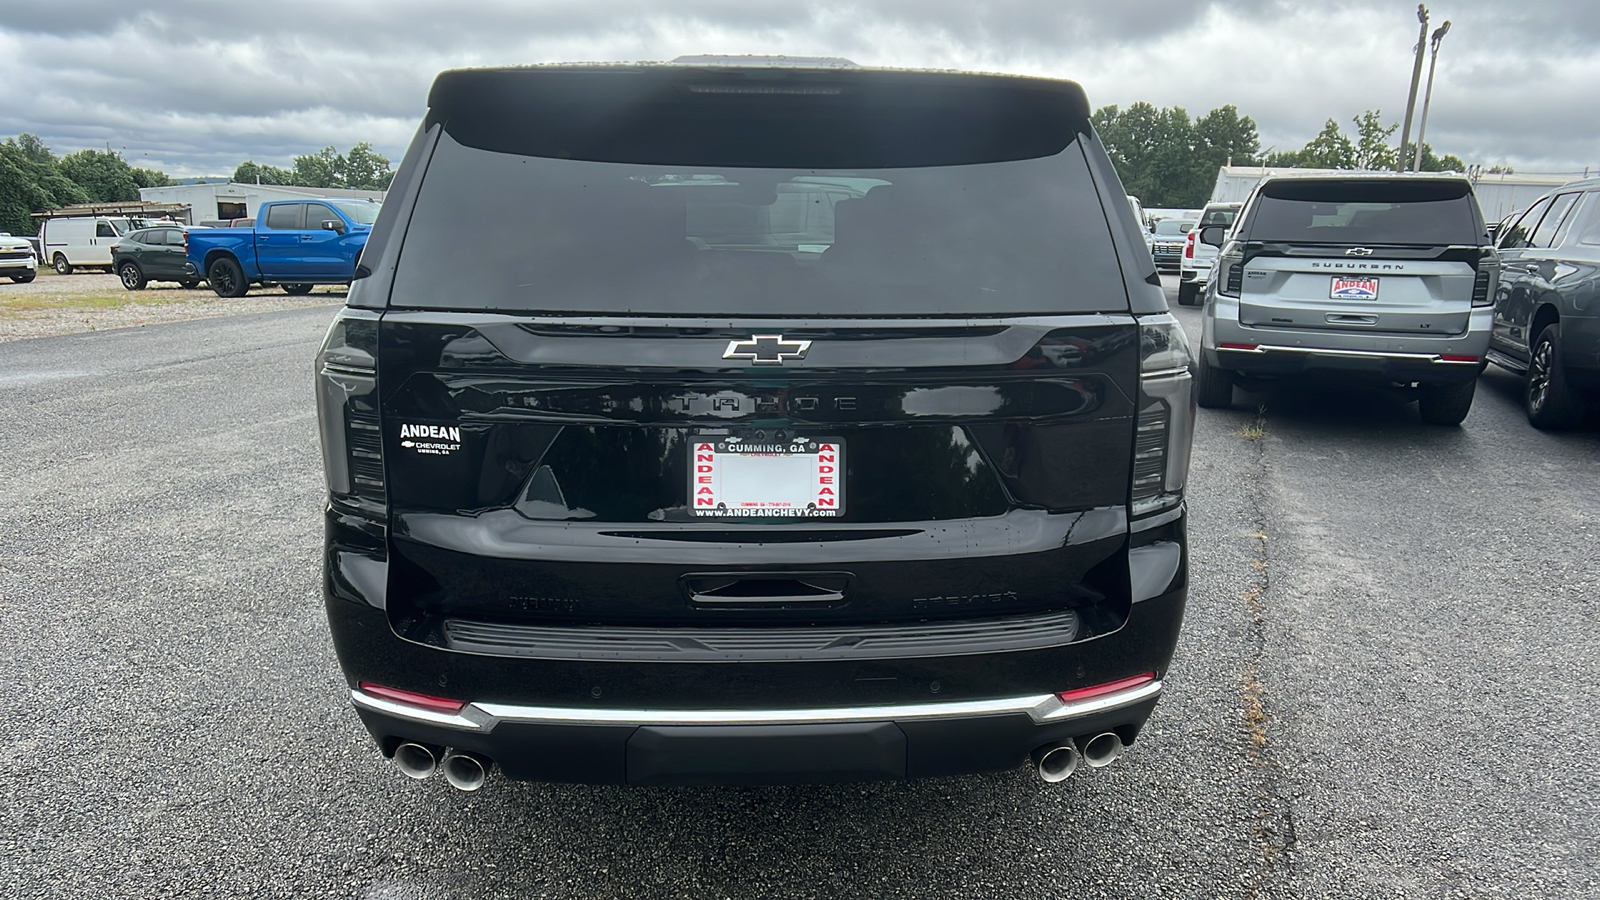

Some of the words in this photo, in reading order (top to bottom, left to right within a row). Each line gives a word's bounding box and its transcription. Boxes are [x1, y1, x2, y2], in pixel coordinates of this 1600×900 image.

[1312, 262, 1404, 270] SUBURBAN
[1334, 280, 1376, 293] ANDEAN
[674, 396, 857, 411] TAHOE
[400, 423, 460, 442] ANDEAN
[415, 442, 460, 450] CHEVROLET
[728, 444, 786, 453] CUMMING,
[789, 444, 805, 452] GA
[697, 443, 714, 506] ANDEAN
[818, 444, 835, 506] ANDEAN
[695, 508, 836, 517] www.ANDEANCHEVY.com
[912, 591, 1018, 609] PREMIER
